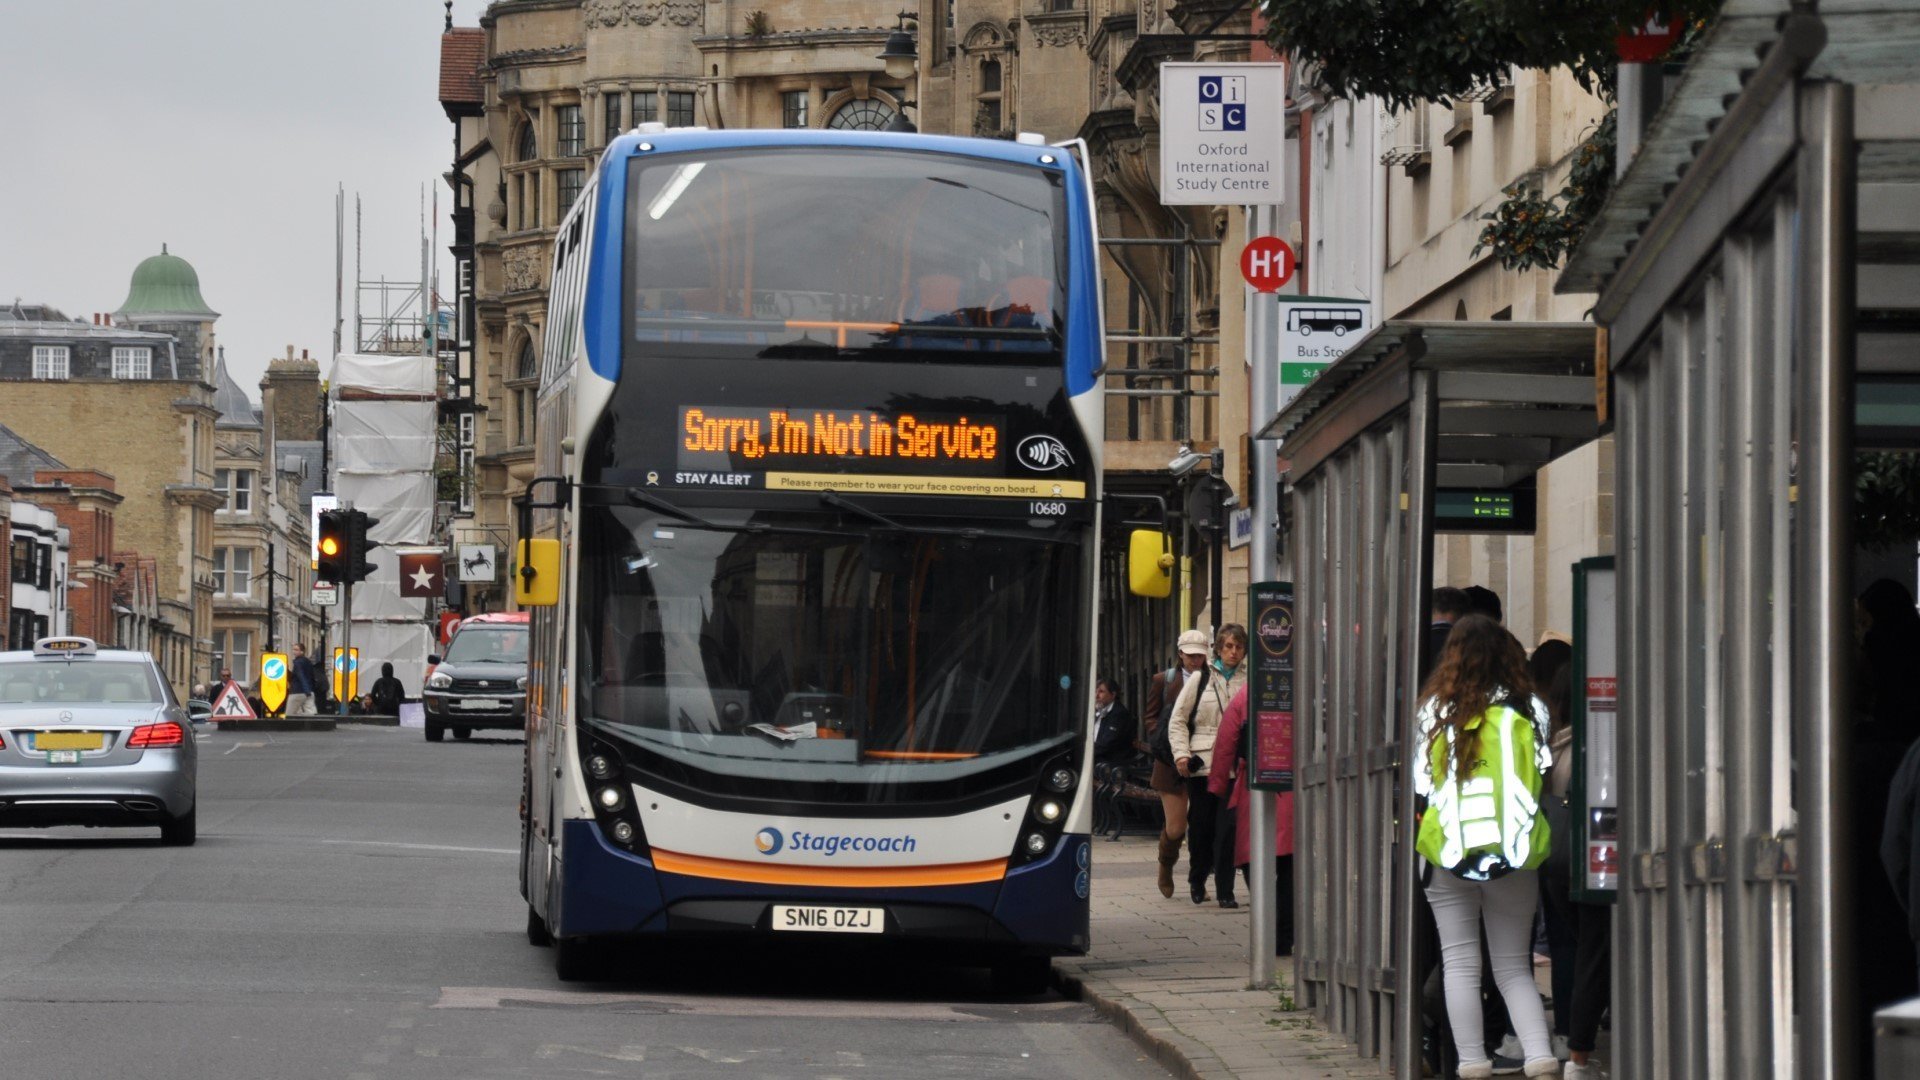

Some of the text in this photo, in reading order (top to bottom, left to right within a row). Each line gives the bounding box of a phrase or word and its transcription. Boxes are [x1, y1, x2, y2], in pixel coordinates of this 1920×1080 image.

[1198, 142, 1247, 156] Oxford
[1176, 160, 1270, 173] International
[1176, 177, 1270, 193] Study Centre
[1250, 250, 1285, 278] H1
[1297, 345, 1347, 358] Bus Sto
[1302, 369, 1312, 378] St
[685, 408, 997, 459] Sorry, I'm Not in Service
[675, 472, 752, 486] STAY ALERT
[781, 477, 812, 488] Please
[813, 479, 864, 490] remember
[865, 481, 876, 490] to
[877, 482, 901, 491] wear
[903, 483, 925, 493] your
[926, 482, 948, 492] face
[949, 483, 991, 494] covering
[1007, 484, 1038, 494] board.
[1030, 502, 1067, 516] 10680
[789, 831, 917, 856] Stagecoach
[785, 908, 872, 928] SN16 OZJ
